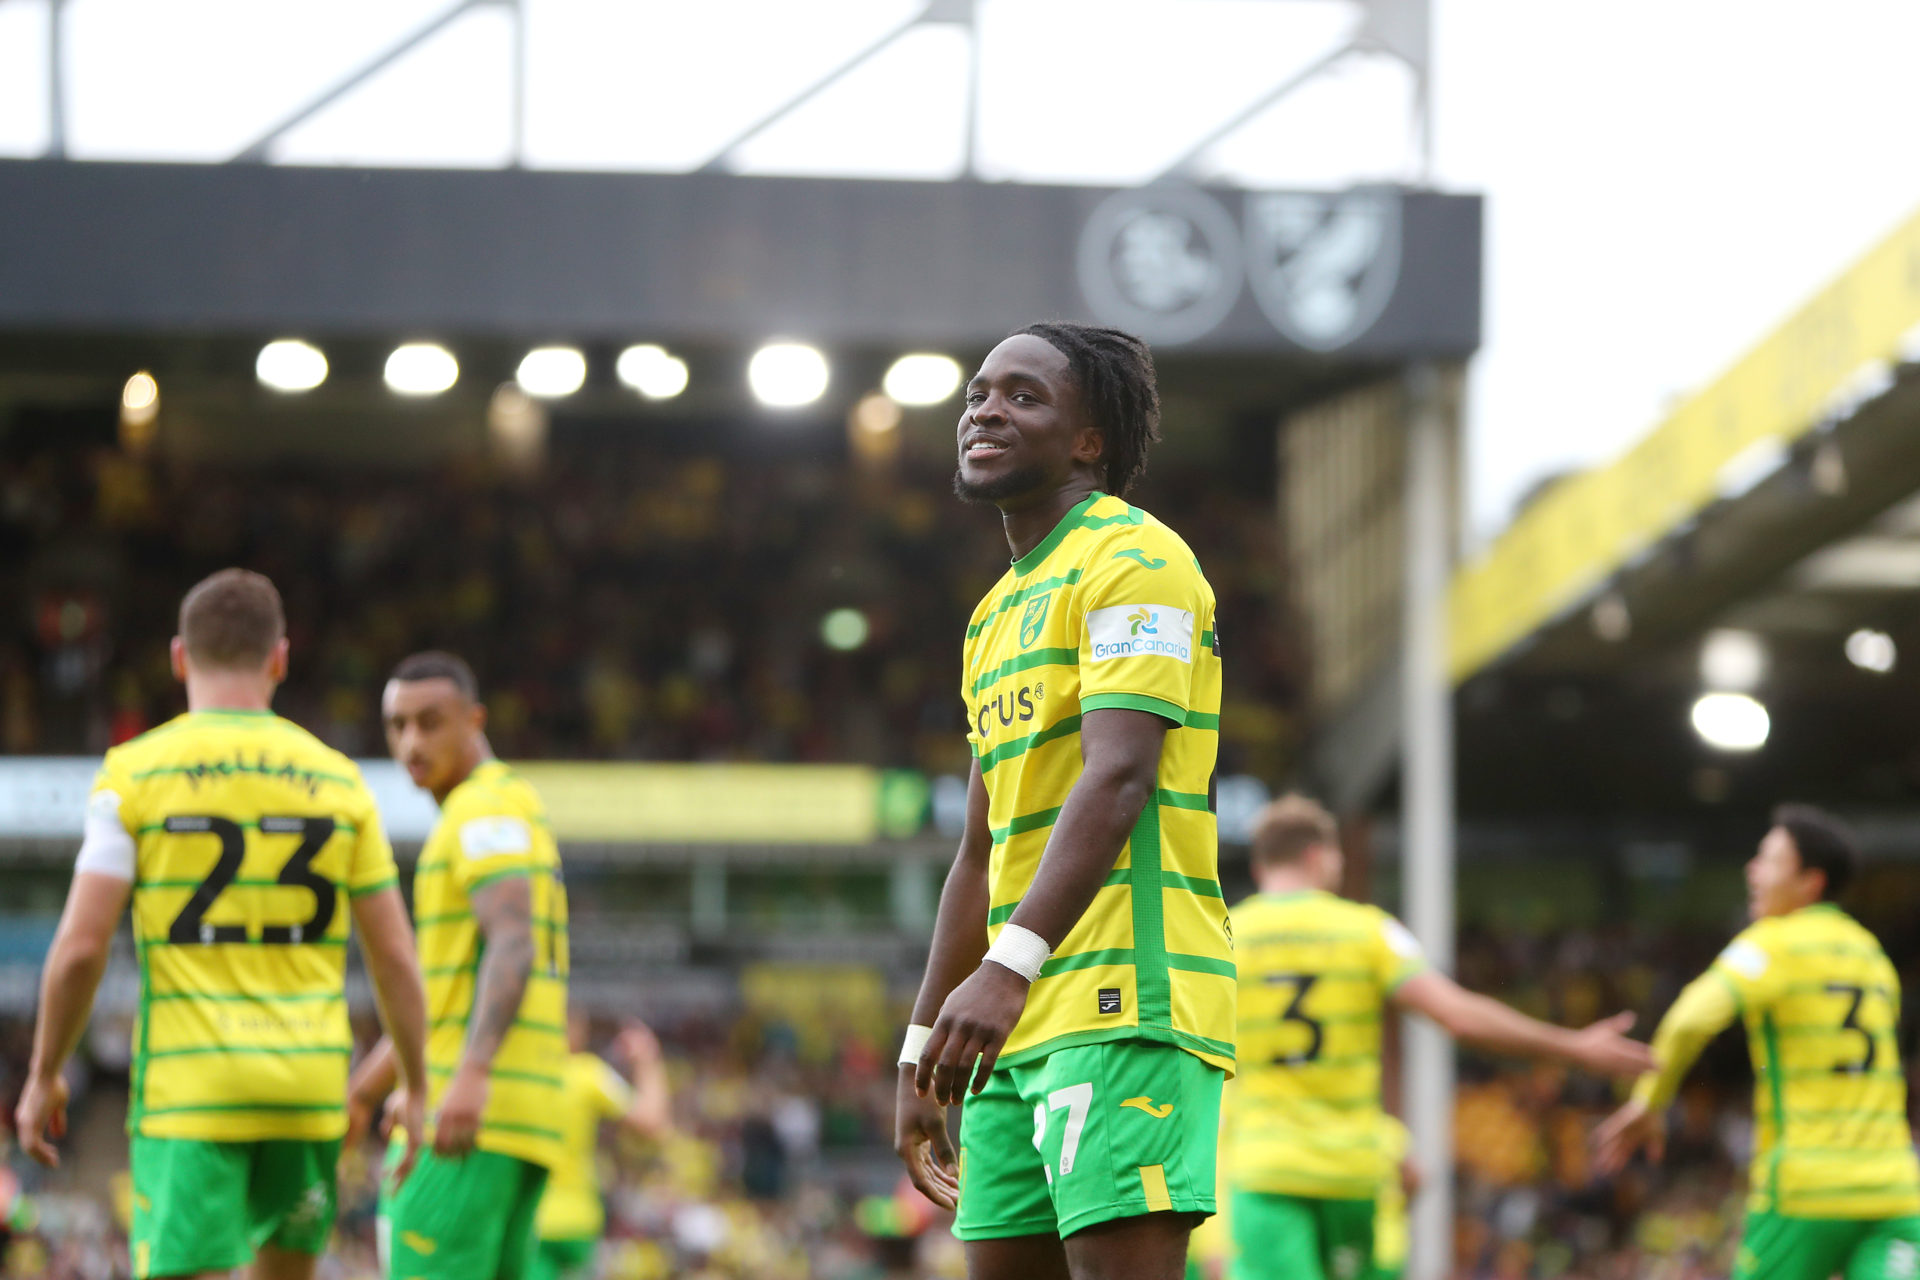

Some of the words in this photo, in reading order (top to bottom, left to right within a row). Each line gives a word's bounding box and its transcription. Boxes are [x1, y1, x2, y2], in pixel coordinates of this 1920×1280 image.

[1095, 638, 1188, 658] GranCanaria
[977, 686, 1035, 738] OUS
[164, 815, 336, 944] 23
[1264, 972, 1323, 1065] 3
